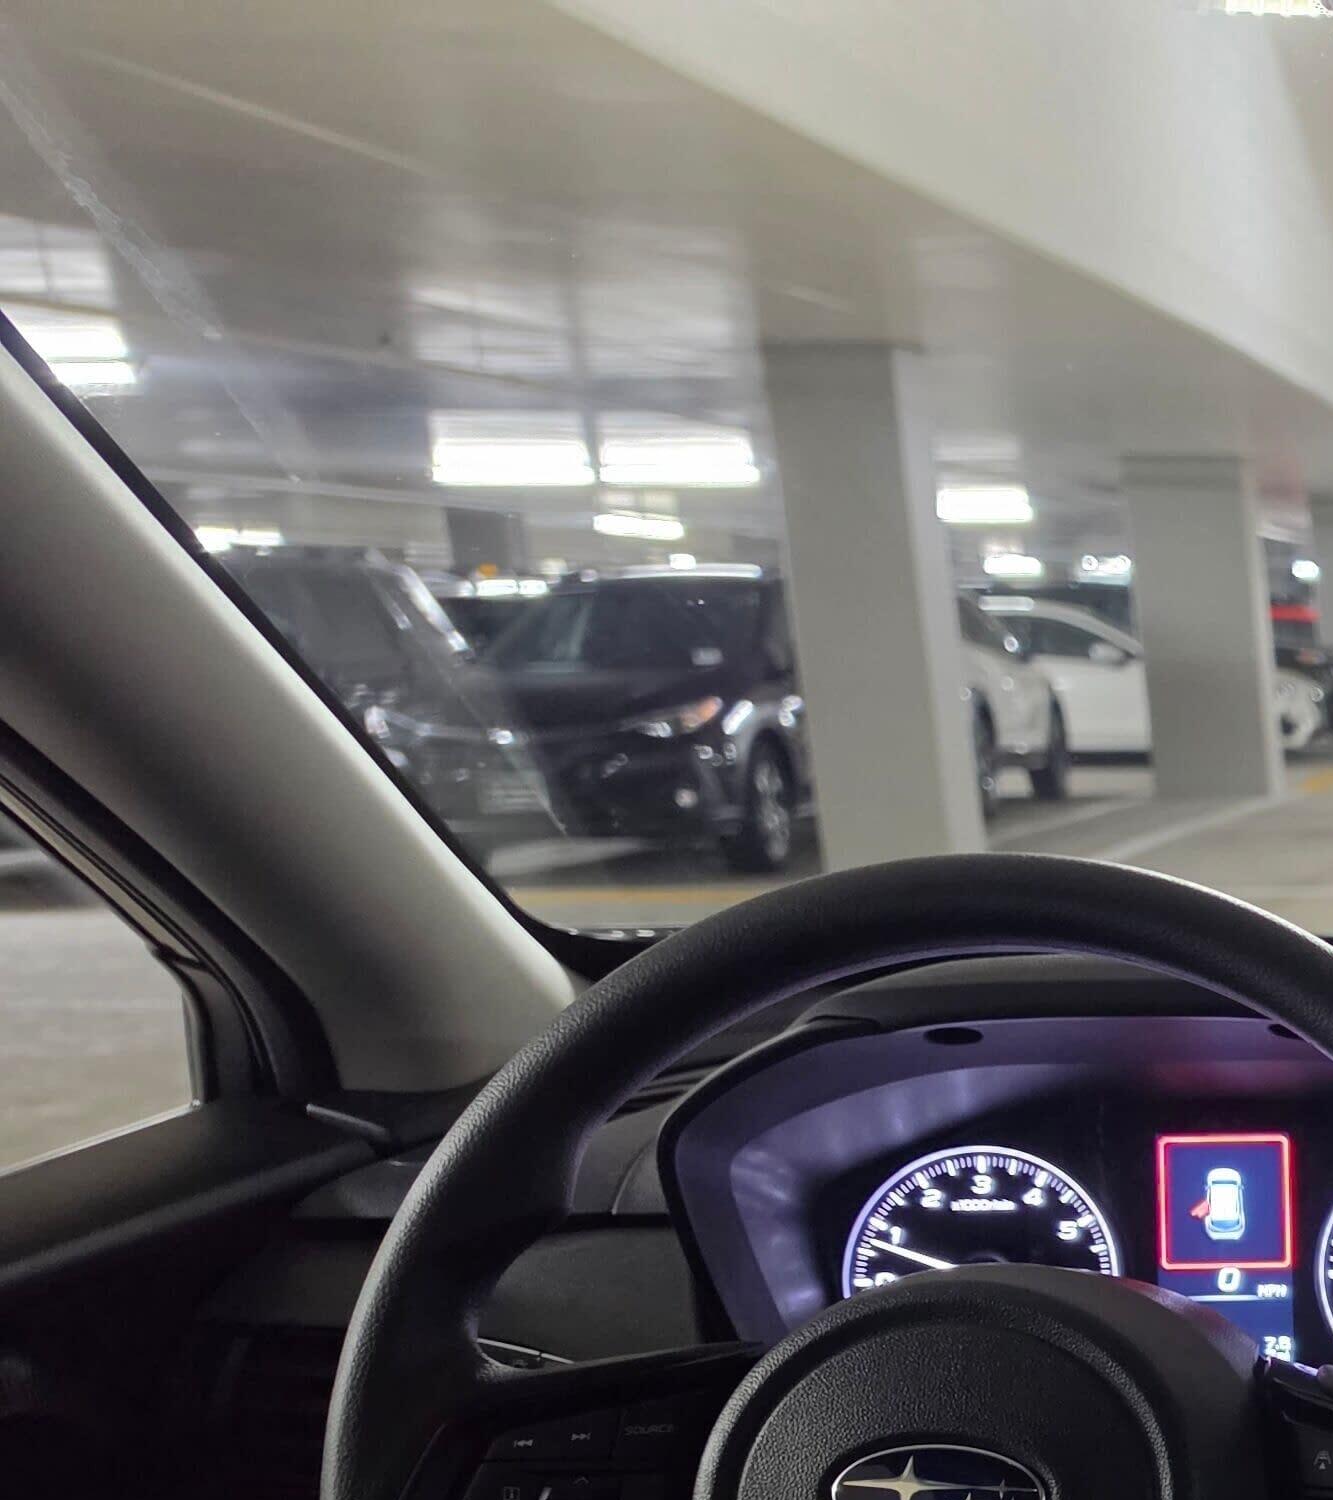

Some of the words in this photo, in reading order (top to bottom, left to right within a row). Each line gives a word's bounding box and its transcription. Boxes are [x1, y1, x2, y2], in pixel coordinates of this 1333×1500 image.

[971, 1174, 993, 1195] 3
[920, 1188, 943, 1208] 2
[1022, 1187, 1044, 1206] 4
[889, 1225, 904, 1245] 1
[1056, 1220, 1078, 1240] 5
[1218, 1267, 1241, 1293] 0
[1257, 1283, 1288, 1298] MPH
